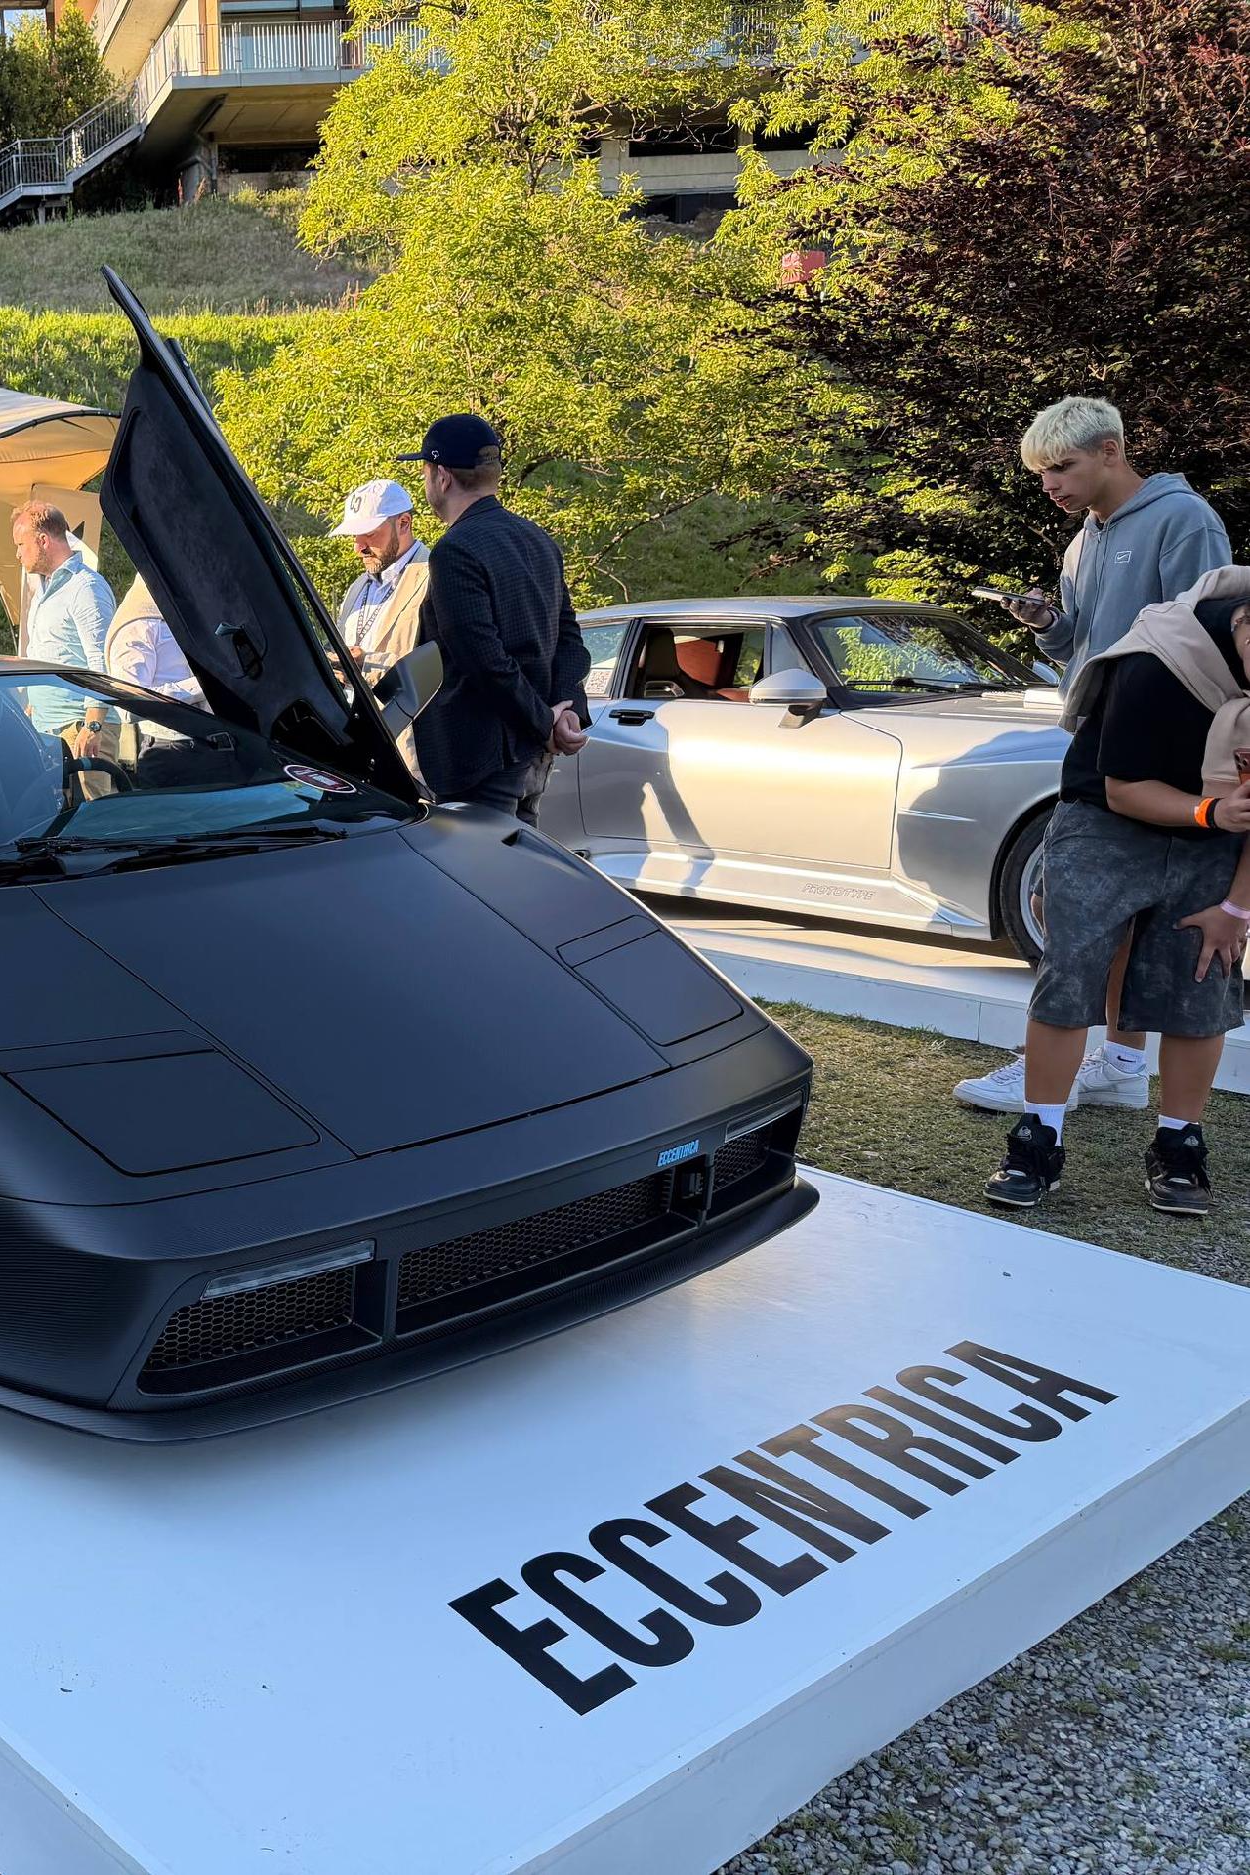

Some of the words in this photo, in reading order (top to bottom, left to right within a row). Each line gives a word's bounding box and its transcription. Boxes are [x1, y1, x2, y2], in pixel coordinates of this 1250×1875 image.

[802, 882, 877, 900] PROTOTYPE
[657, 1139, 699, 1167] ECCENTRICA
[447, 1340, 1119, 1715] ECCENTRICA
